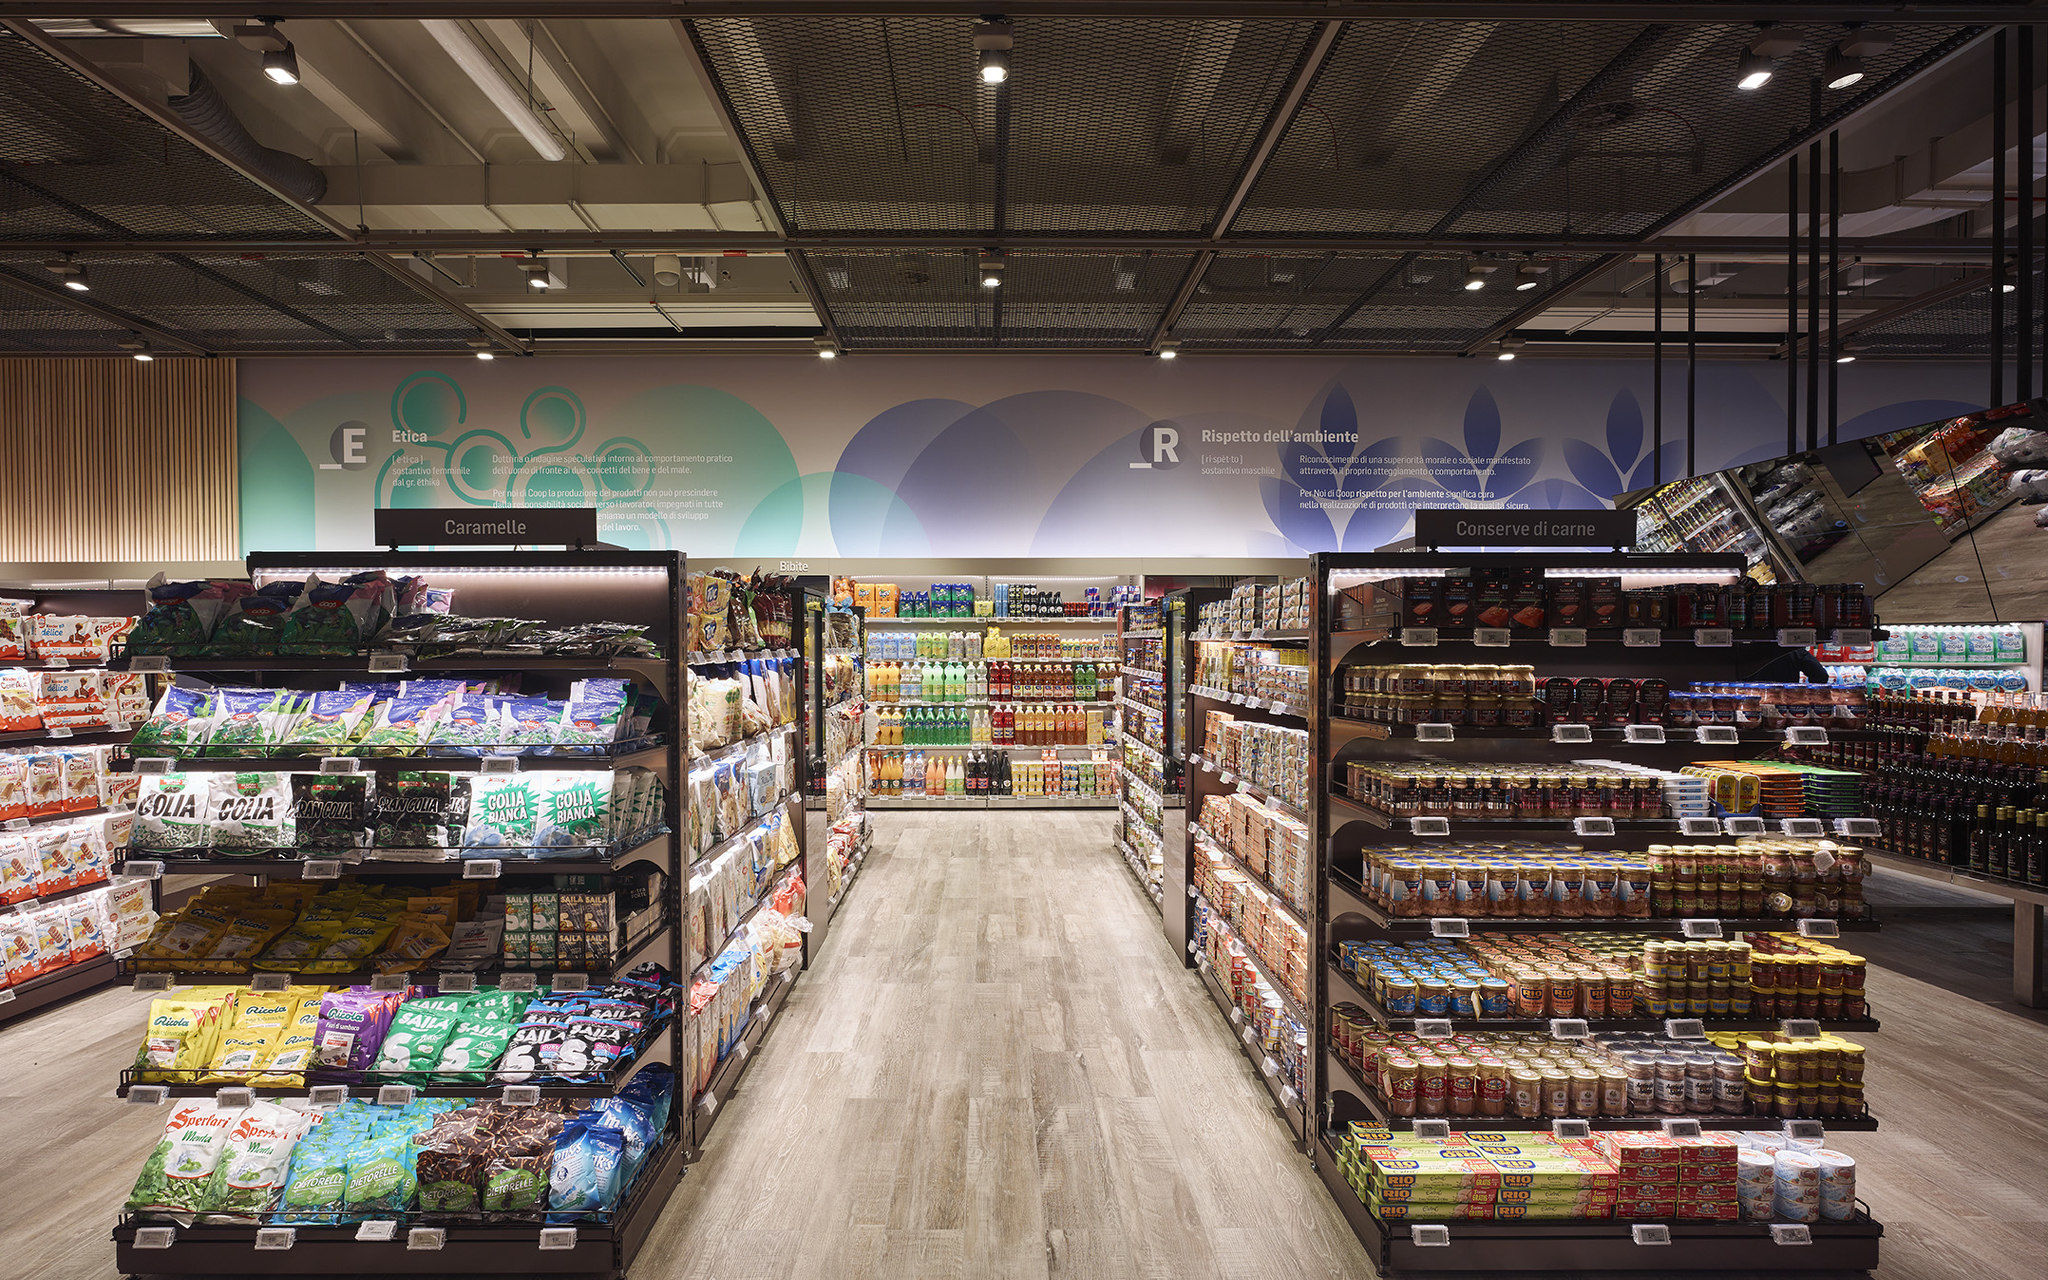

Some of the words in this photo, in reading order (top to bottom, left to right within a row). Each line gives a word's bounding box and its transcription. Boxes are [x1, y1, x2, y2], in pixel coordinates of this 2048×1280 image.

[392, 430, 428, 443] Etica
[1201, 429, 1261, 445] Rispetto
[492, 454, 523, 464] Dottrina
[530, 454, 564, 464] indagine
[564, 454, 606, 464] speculativa
[607, 454, 635, 464] intorno
[636, 454, 644, 464] al
[644, 454, 705, 464] comportamento
[706, 454, 733, 464] pratico
[1299, 455, 1359, 464] Riconoscimento
[1360, 455, 1367, 464] di
[1384, 455, 1423, 465] superiorità
[1425, 455, 1452, 465] morale
[1458, 455, 1485, 465] sociale
[1486, 455, 1531, 465] manifestato
[392, 467, 431, 475] sostantivo
[432, 467, 470, 475] femminile
[531, 466, 538, 475] di
[539, 466, 563, 475] fronte
[572, 466, 585, 475] due
[586, 466, 618, 475] concetti
[619, 466, 630, 475] del
[632, 466, 650, 475] bene
[657, 466, 669, 475] del
[670, 466, 692, 475] male.
[1201, 467, 1242, 475] sostantivo
[1243, 467, 1276, 475] maschile
[1299, 467, 1338, 475] attraverso
[1339, 467, 1344, 475] il
[1345, 467, 1372, 477] proprio
[1373, 467, 1428, 477] atteggiamento
[1435, 467, 1497, 477] comportamento.
[392, 478, 405, 486] dal
[492, 489, 505, 497] Per
[518, 489, 526, 497] di
[527, 489, 547, 498] Coop
[548, 489, 556, 497] la
[556, 489, 598, 498] produzione
[612, 489, 642, 498] prodotti
[643, 489, 658, 497] non
[659, 489, 673, 498] può
[674, 489, 718, 498] prescindere
[1299, 489, 1313, 497] Per
[1313, 489, 1327, 497] Noi
[1327, 489, 1335, 497] di
[1336, 489, 1355, 498] Coop
[1356, 489, 1387, 498] rispetto
[1388, 490, 1401, 498] per
[1445, 489, 1477, 499] significa
[595, 500, 615, 509] verso
[619, 500, 654, 509] lavoratori
[657, 500, 694, 510] impegnati
[704, 500, 724, 509] tutte
[1299, 501, 1319, 509] nella
[1320, 501, 1368, 509] realizzazione
[1377, 501, 1407, 510] prodotti
[1408, 501, 1422, 509] che
[1422, 501, 1469, 509] interpretano
[1478, 501, 1505, 509] qualità
[1505, 501, 1531, 509] sicura.
[637, 512, 668, 520] modello
[677, 512, 709, 521] sviluppo
[444, 518, 526, 535] Caramelle
[615, 523, 641, 531] lavoro.
[1456, 520, 1530, 536] Conserve
[1533, 520, 1548, 536] di
[1551, 523, 1596, 536] carne
[780, 561, 809, 572] Bibite
[42, 628, 63, 636] délice
[94, 620, 122, 638] fiesta
[102, 673, 128, 690] fiesta
[47, 684, 69, 692] délice
[108, 779, 135, 797] fiesta
[487, 789, 526, 811] GOLIA
[555, 789, 594, 810] GOLIA
[137, 792, 197, 819] GOLIA
[218, 796, 275, 822] GOLIA
[487, 806, 528, 824] BIANCA
[557, 806, 596, 824] BIANCA
[113, 886, 139, 902] brioss
[505, 896, 529, 904] SAILA
[560, 896, 585, 904] SAILA
[585, 896, 608, 904] SAILA
[504, 934, 528, 942] SAILA
[558, 934, 583, 942] SAILA
[1523, 988, 1542, 996] RIO
[1554, 988, 1574, 996] RIO
[1612, 989, 1632, 997] RIO
[245, 1005, 288, 1015] Ricola
[327, 1007, 365, 1022] Ricola
[590, 1009, 642, 1019] SAILA
[153, 1015, 190, 1028] Ricola
[398, 1012, 450, 1030] SAILA
[456, 1021, 511, 1040] SAILA
[568, 1024, 621, 1043] SAILA
[515, 1028, 567, 1044] SAILA
[165, 1106, 232, 1135] Sperlari
[181, 1129, 213, 1144] Menta
[247, 1141, 274, 1156] Menta
[349, 1165, 399, 1189] DIETORELLE
[1387, 1176, 1415, 1184] RIO
[1505, 1175, 1532, 1183] RIO
[485, 1178, 533, 1196] DIETORELLE
[1383, 1189, 1410, 1198] RIO
[1502, 1191, 1529, 1199] RIO
[1380, 1206, 1407, 1215] RIO
[1499, 1206, 1526, 1215] RIO
